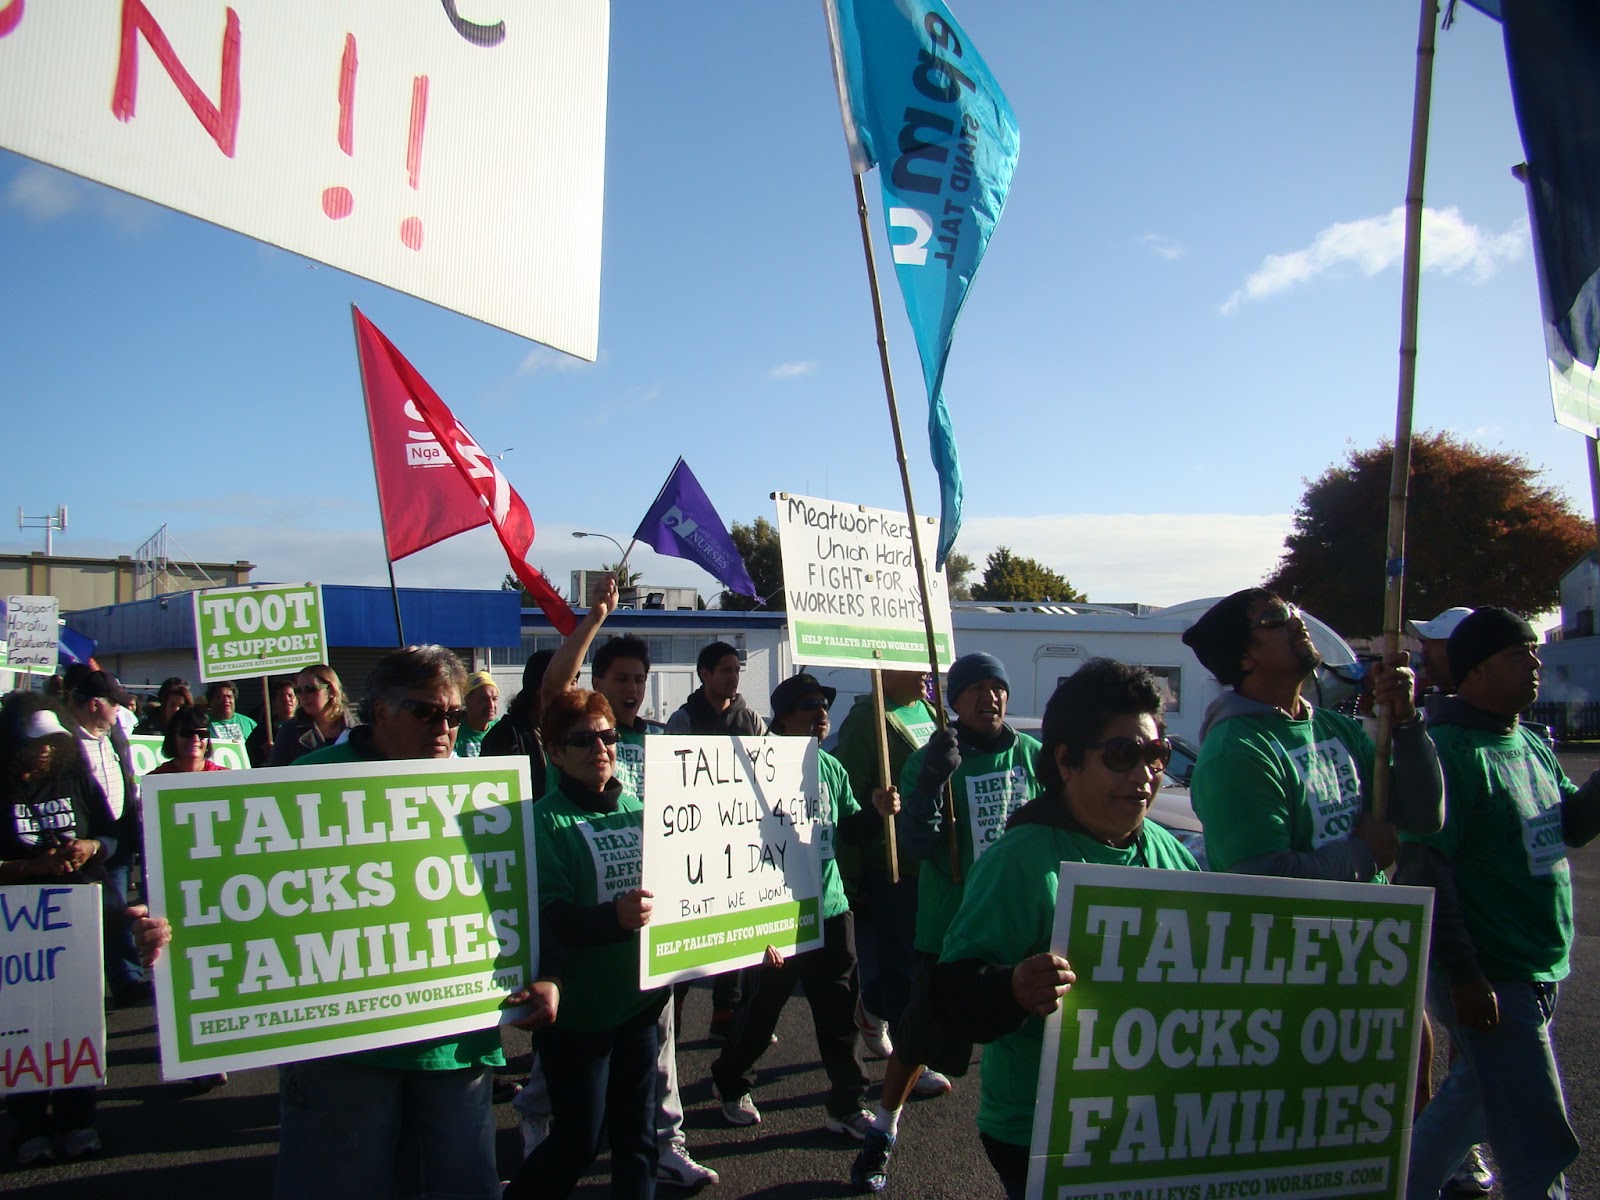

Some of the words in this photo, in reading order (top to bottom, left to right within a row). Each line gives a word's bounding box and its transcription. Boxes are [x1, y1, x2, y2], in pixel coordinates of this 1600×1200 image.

[411, 447, 440, 460] Nga
[690, 530, 730, 570] NURSES
[817, 535, 869, 562] Union
[876, 544, 912, 568] Hard
[808, 563, 863, 590] FIGHT
[875, 570, 904, 592] FOR
[9, 595, 58, 617] Support
[203, 592, 315, 636] TOOT
[790, 591, 865, 617] WORKERS
[870, 595, 925, 622] RIGHTS
[207, 643, 220, 659] 4
[223, 633, 318, 658] SUPPORT
[801, 634, 824, 645] HELP
[823, 636, 860, 647] TALLEYS
[861, 639, 888, 650] AFFCO
[887, 641, 925, 651] WORKERS
[226, 661, 254, 670] TALLEYS
[254, 659, 274, 667] AFFCO
[274, 656, 303, 665] WORKERS
[674, 738, 776, 788] TALLY'S
[1491, 748, 1522, 763] OTUEKA
[174, 781, 513, 860] TALLEYS
[718, 798, 763, 827] WILL
[772, 798, 785, 826] 4
[790, 796, 819, 826] GIVE
[592, 832, 639, 851] HELP
[600, 849, 643, 862] TALLEY
[605, 860, 643, 879] AFFC
[724, 843, 733, 879] 1
[747, 840, 787, 873] DAY
[180, 861, 396, 927] LOCKS
[415, 850, 516, 901] OUT
[605, 876, 643, 890] WORKE
[0, 888, 73, 932] WE
[728, 891, 747, 910] WE
[656, 939, 682, 957] HELP
[682, 931, 725, 951] TALLEYS
[726, 926, 755, 944] AFFCO
[755, 918, 795, 937] WORKERS
[1086, 904, 1411, 986] TALLEYS
[0, 946, 66, 991] our
[186, 908, 521, 1001] FAMILIES
[200, 1016, 251, 1036] HELP
[255, 1002, 341, 1028] TALLEYS
[345, 993, 402, 1016] AFFCO
[406, 980, 484, 1005] WORKERS
[487, 973, 520, 993] .COM
[1072, 1007, 1282, 1071] LOCKS
[1300, 1007, 1405, 1065] OUT
[1062, 1081, 1396, 1168] FAMILIES
[1205, 1178, 1261, 1199] AFFCO
[1265, 1170, 1344, 1193] WORKERS
[1346, 1166, 1384, 1186] .COM
